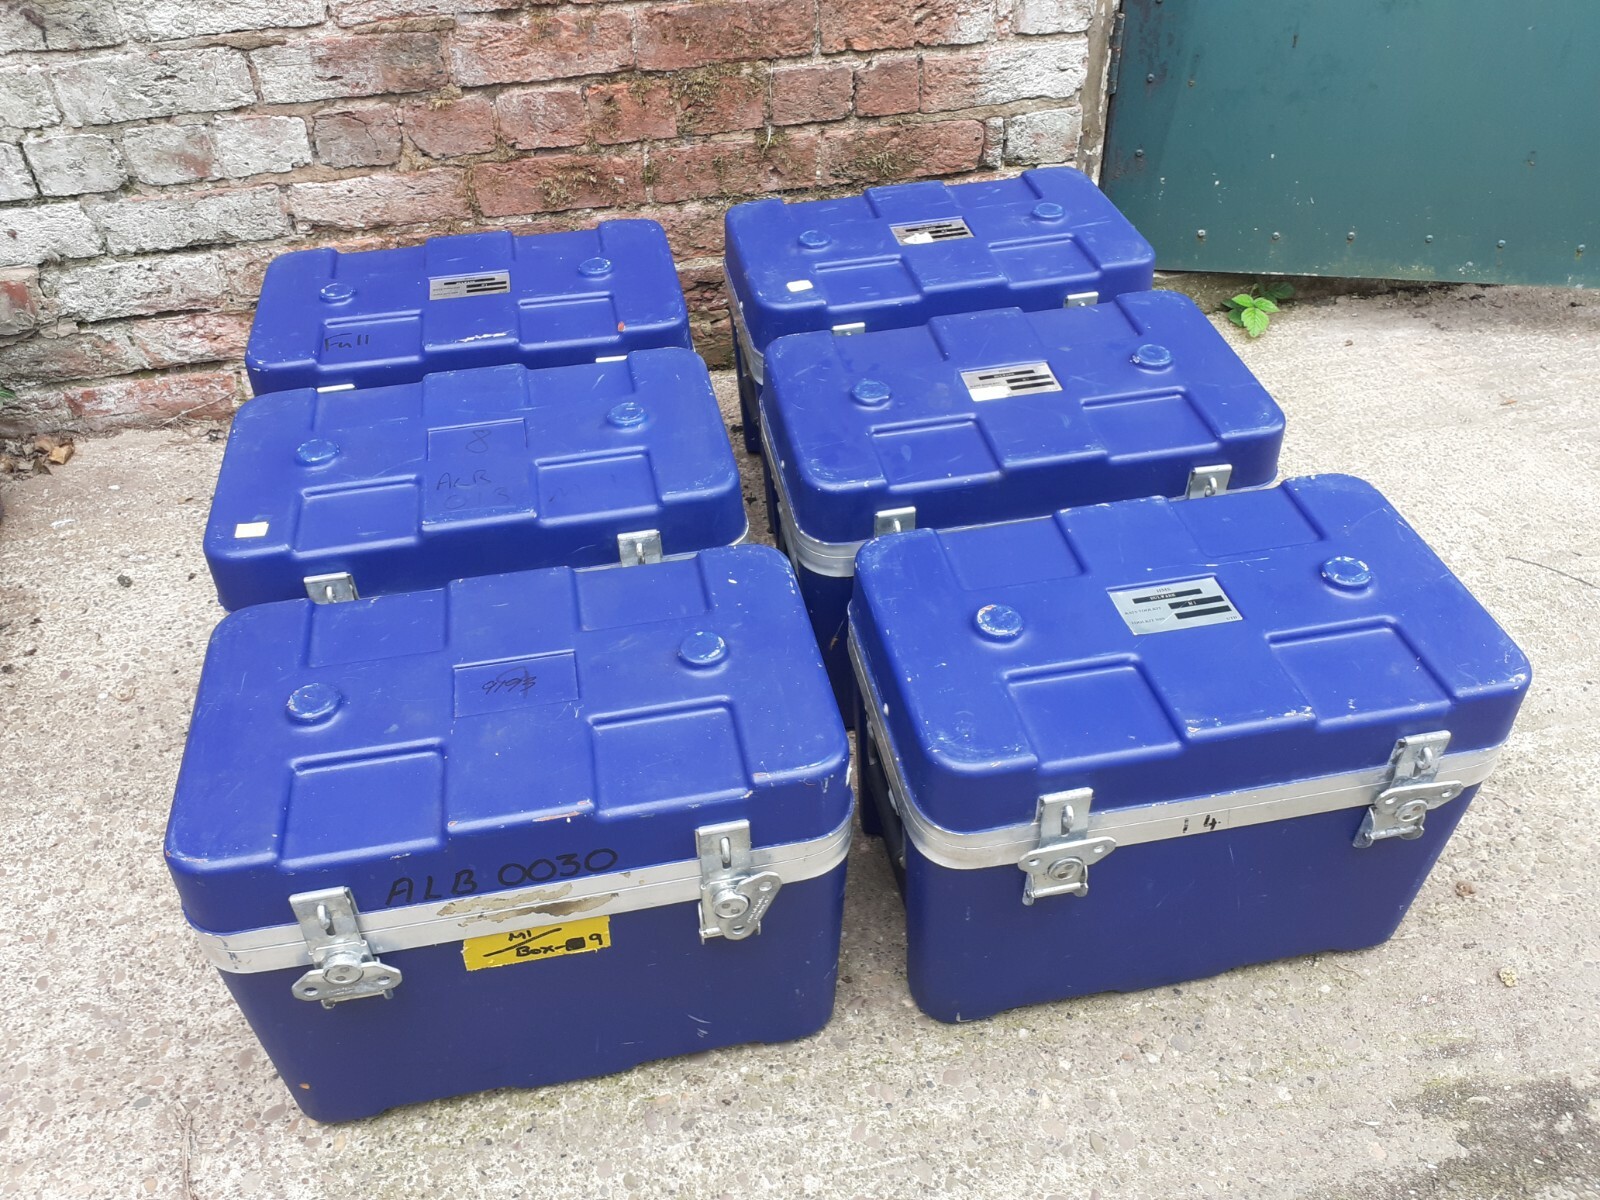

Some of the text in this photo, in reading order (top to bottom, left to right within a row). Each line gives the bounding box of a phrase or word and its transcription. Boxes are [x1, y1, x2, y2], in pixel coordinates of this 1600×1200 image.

[465, 429, 491, 453] 8
[386, 848, 618, 905] ALB 0030
